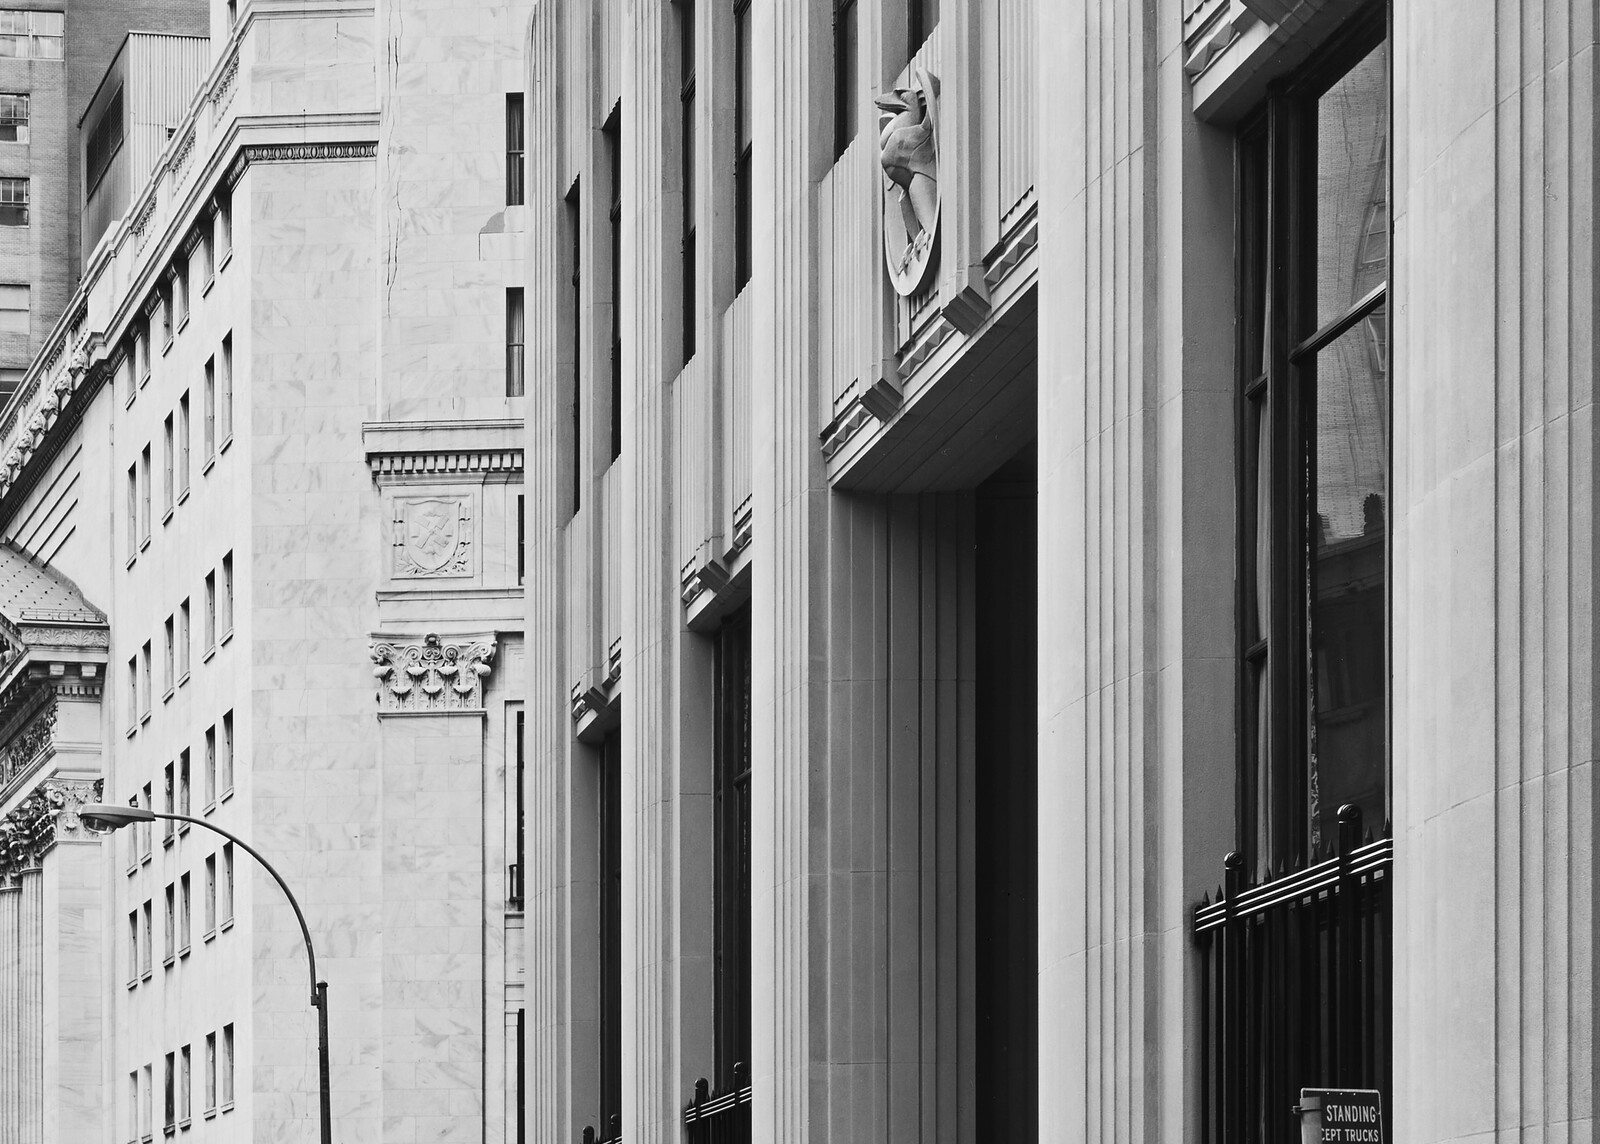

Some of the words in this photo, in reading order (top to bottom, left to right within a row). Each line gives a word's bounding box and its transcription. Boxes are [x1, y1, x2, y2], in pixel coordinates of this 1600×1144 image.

[1326, 1105, 1376, 1123] STANDING
[1321, 1128, 1341, 1141] CEPT
[1345, 1129, 1379, 1142] TRUCKS
